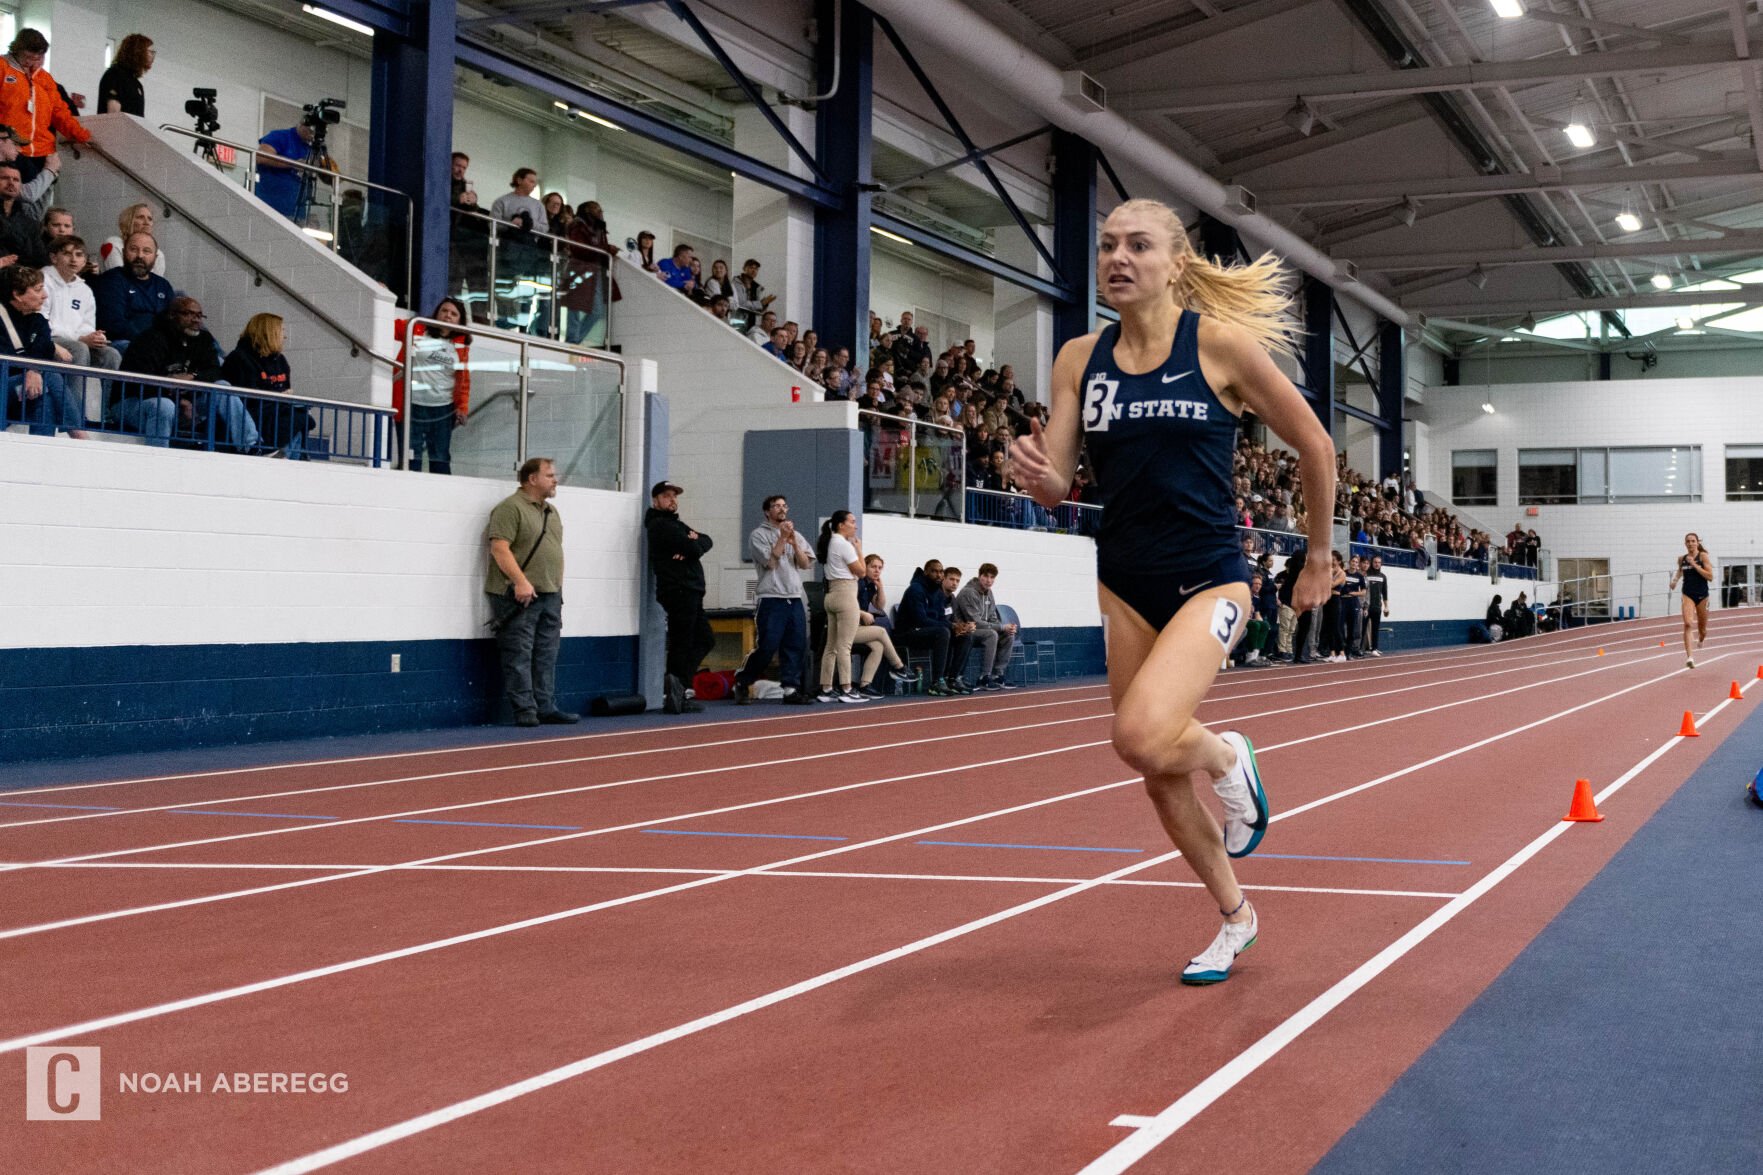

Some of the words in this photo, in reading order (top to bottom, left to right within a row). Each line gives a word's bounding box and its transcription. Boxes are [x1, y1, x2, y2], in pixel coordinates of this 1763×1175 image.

[71, 299, 81, 310] S
[1087, 383, 1108, 428] 3
[1128, 400, 1208, 420] STATE
[1217, 601, 1238, 644] 3
